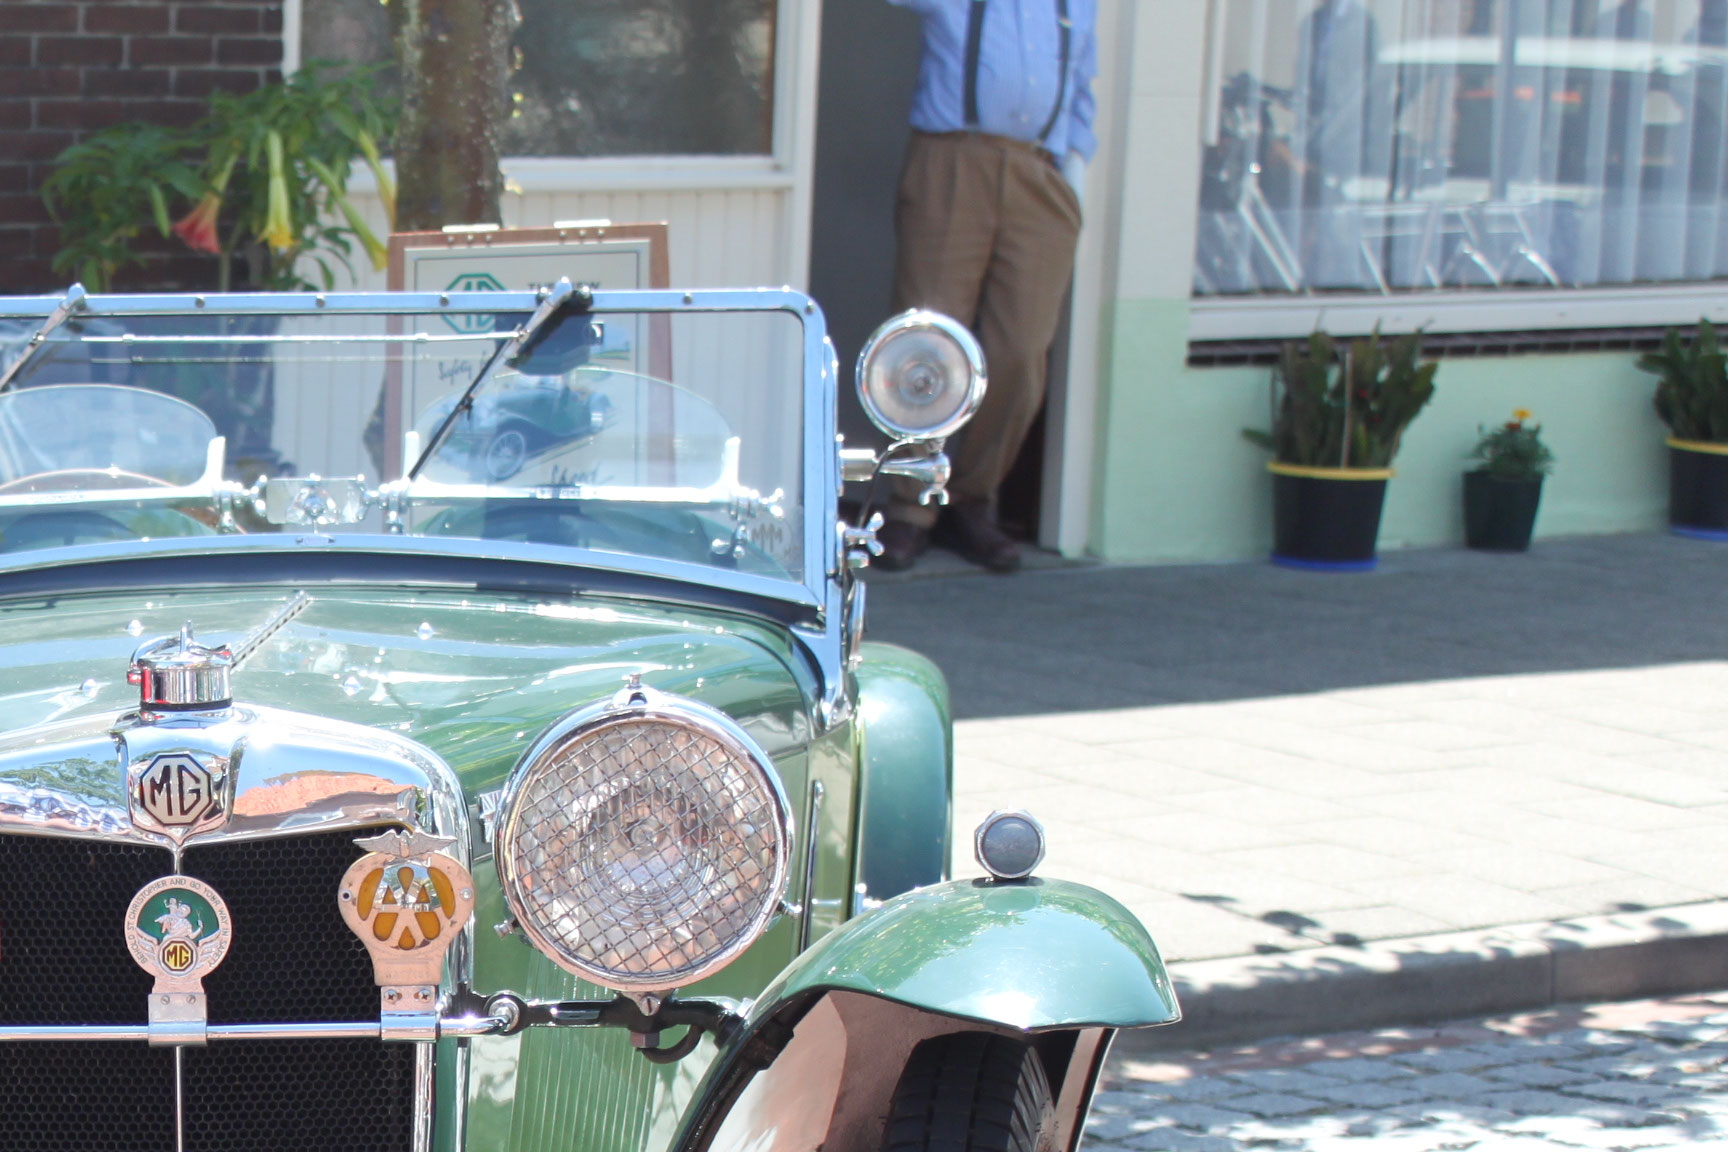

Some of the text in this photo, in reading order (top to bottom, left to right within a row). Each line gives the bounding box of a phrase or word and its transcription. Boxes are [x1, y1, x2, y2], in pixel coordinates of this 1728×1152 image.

[150, 764, 201, 817] MG
[130, 880, 168, 920] CHRISTOPHER
[169, 878, 187, 886] AND
[189, 881, 201, 889] GO
[166, 945, 190, 968] MG
